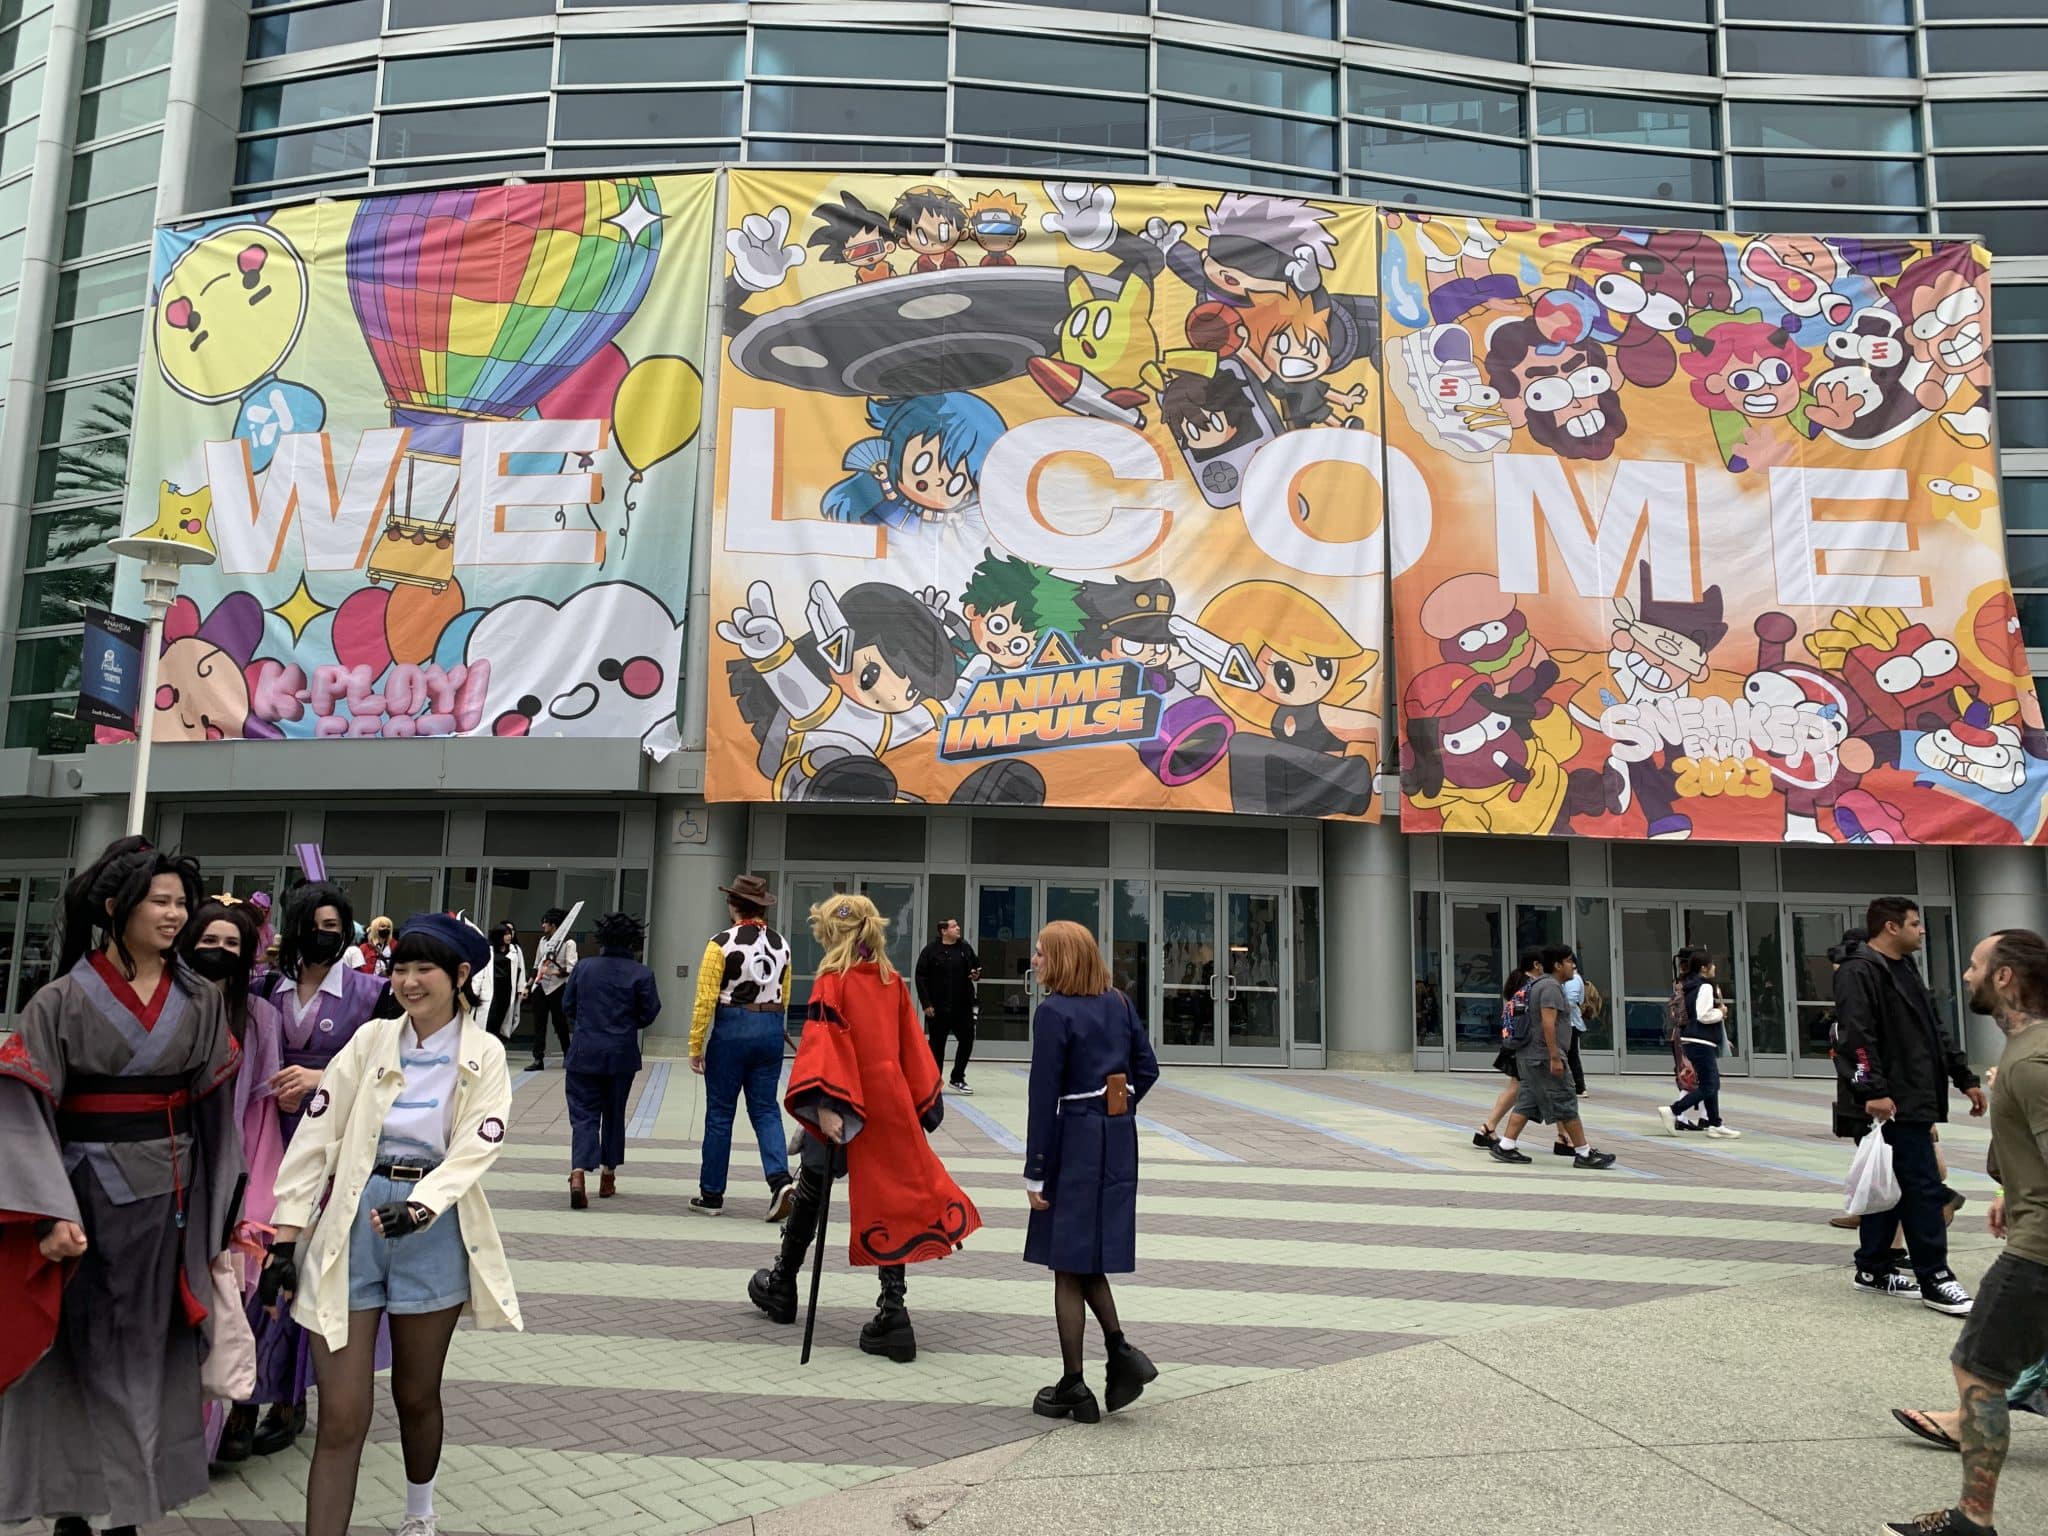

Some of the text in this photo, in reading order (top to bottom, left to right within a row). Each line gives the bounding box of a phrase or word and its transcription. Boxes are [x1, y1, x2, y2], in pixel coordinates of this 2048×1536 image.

[204, 408, 1932, 608] WELCOME
[963, 665, 1124, 717] ANIME
[944, 696, 1146, 754] IMPULSE
[1600, 695, 1838, 783] SNEAKER
[1682, 735, 1753, 762] EXPO
[1671, 756, 1774, 798] 2023
